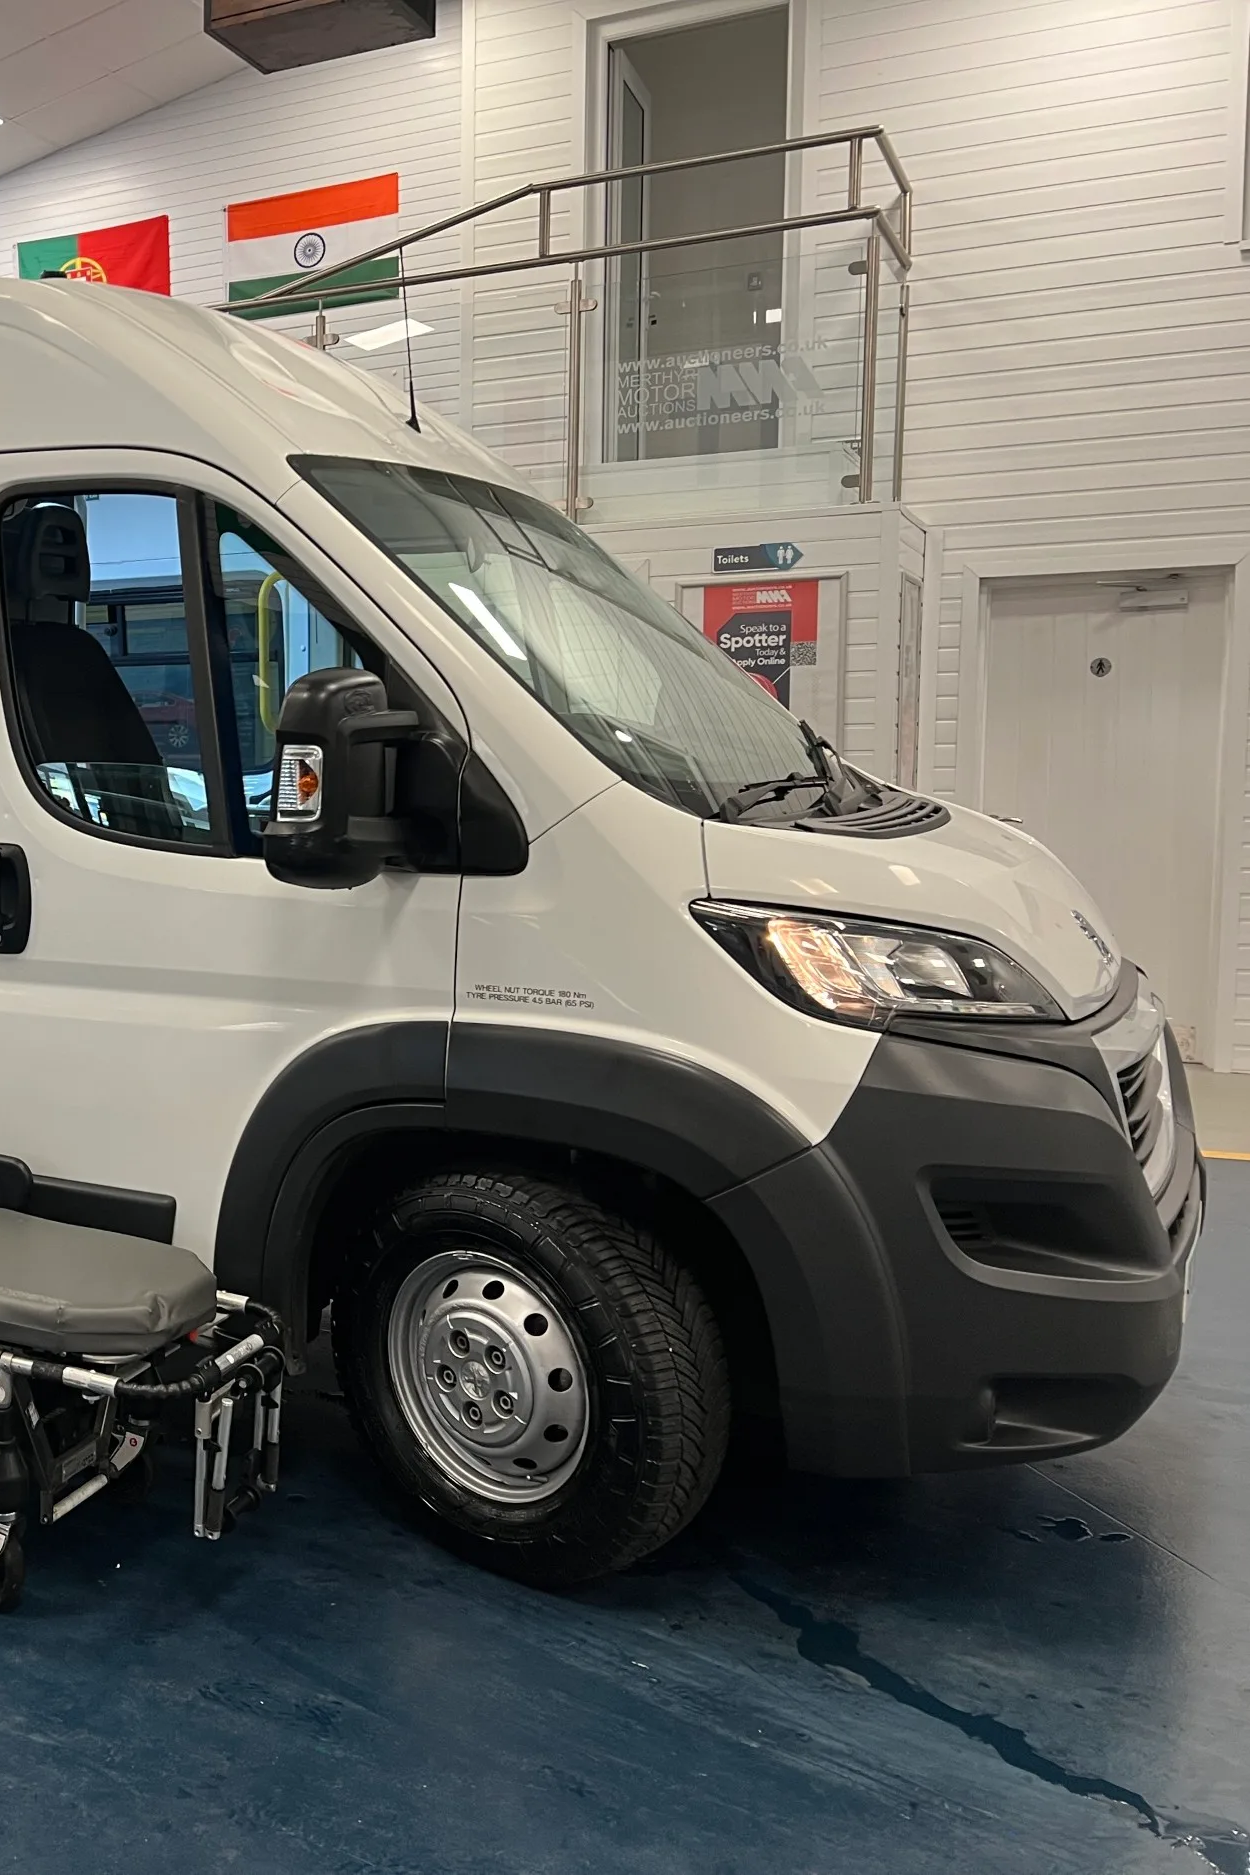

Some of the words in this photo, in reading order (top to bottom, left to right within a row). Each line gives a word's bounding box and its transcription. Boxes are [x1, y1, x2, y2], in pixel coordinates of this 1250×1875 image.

[618, 336, 828, 373] www.auctioneers.co.uk
[618, 367, 699, 389] MERTHYR
[618, 382, 695, 406] MOTOR
[617, 399, 696, 419] AUCTIONS
[617, 403, 827, 434] www.auctioneers.co.uk
[717, 555, 749, 564] Toilets
[740, 624, 768, 634] Speak
[719, 634, 787, 652] Spotter
[755, 649, 778, 657] Today
[779, 648, 786, 656] &
[757, 657, 786, 665] Online
[475, 984, 502, 993] WHEEL
[504, 986, 520, 994] NUT
[523, 988, 555, 997] TORQUE
[466, 991, 486, 1000] TYRE
[488, 993, 530, 1003] PRESSURE
[565, 1000, 577, 1008] (65
[579, 1000, 595, 1009] PSI)
